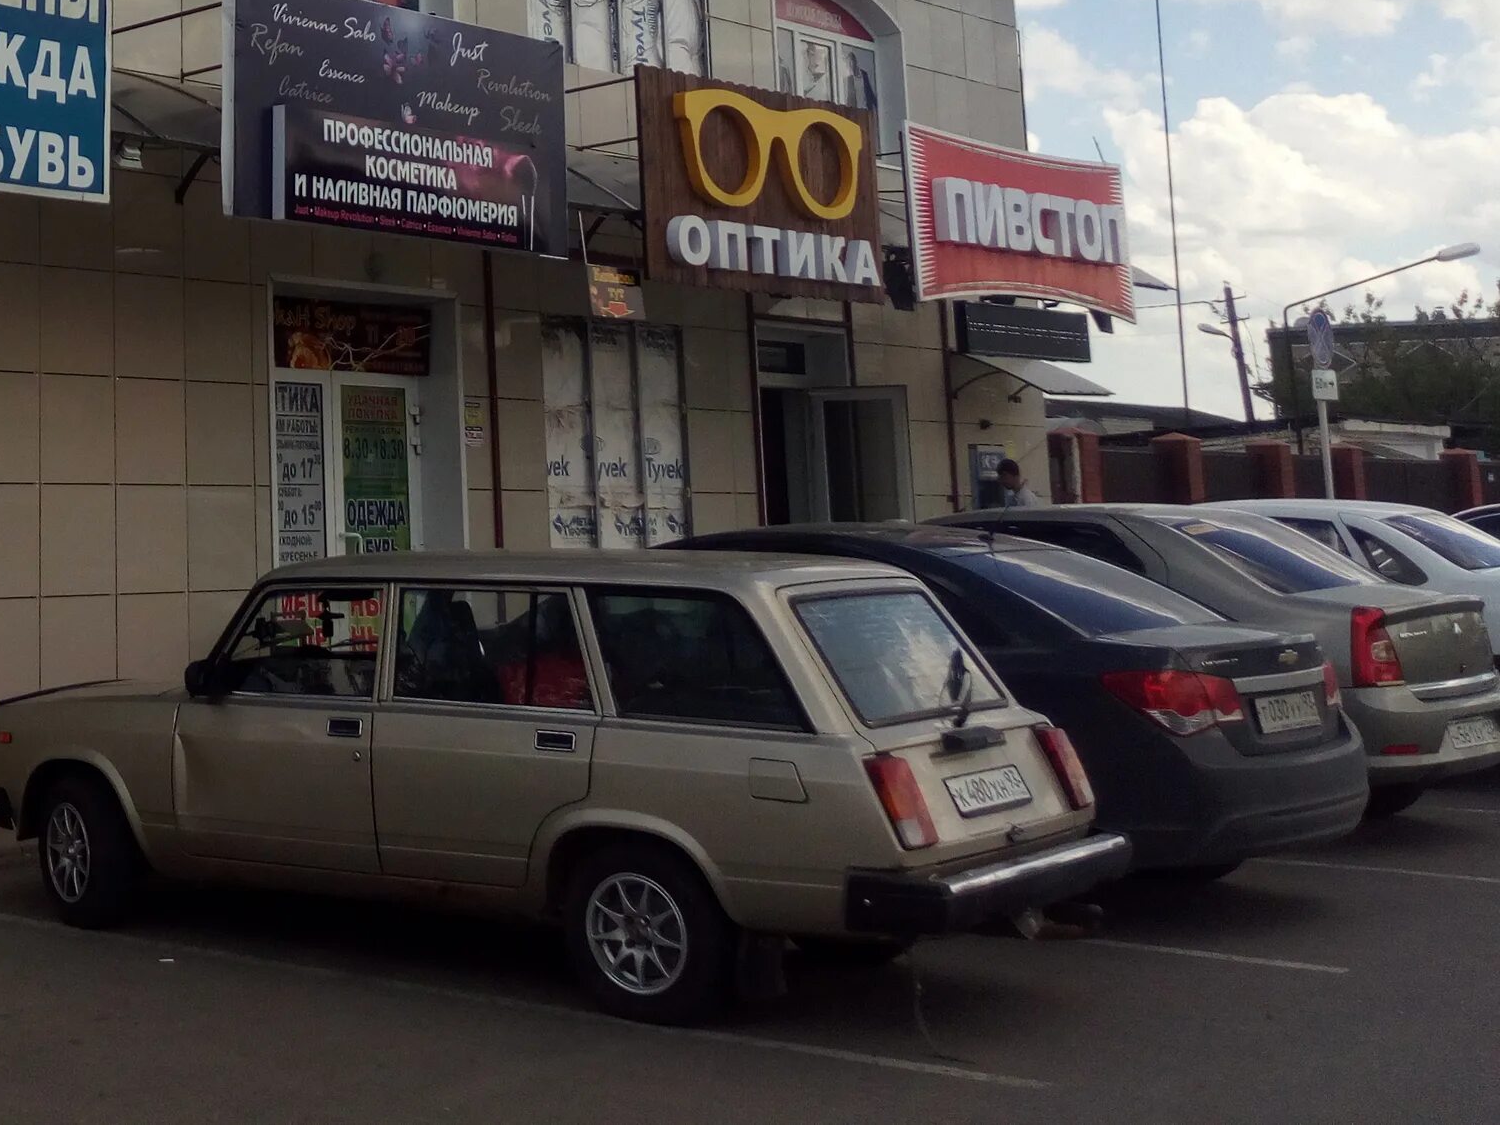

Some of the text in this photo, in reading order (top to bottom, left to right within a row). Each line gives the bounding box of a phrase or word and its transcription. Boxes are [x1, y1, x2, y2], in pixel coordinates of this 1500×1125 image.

[272, 3, 377, 42] Vivienne Sabo
[251, 23, 304, 64] Refan
[450, 32, 488, 66] Just
[318, 59, 365, 84] Essence
[476, 69, 552, 102] Revolution
[278, 75, 334, 104] Catrice
[416, 91, 481, 125] Makeup
[323, 119, 493, 168] ПРОФЕССИОНАЛЬНАЯ
[365, 155, 457, 191] КОСМЕТИКА
[294, 174, 518, 227] И НАЛИВНАЯ ПАРФЮМЕРИЯ
[931, 176, 1128, 265] ПИВСТОП
[667, 214, 880, 286] ОПТИКА
[275, 385, 319, 413] ТИКА
[348, 393, 398, 407] УДАЧНАЯ
[348, 408, 398, 420] ПОКУПКА
[347, 499, 407, 531] ОДЕЖДА
